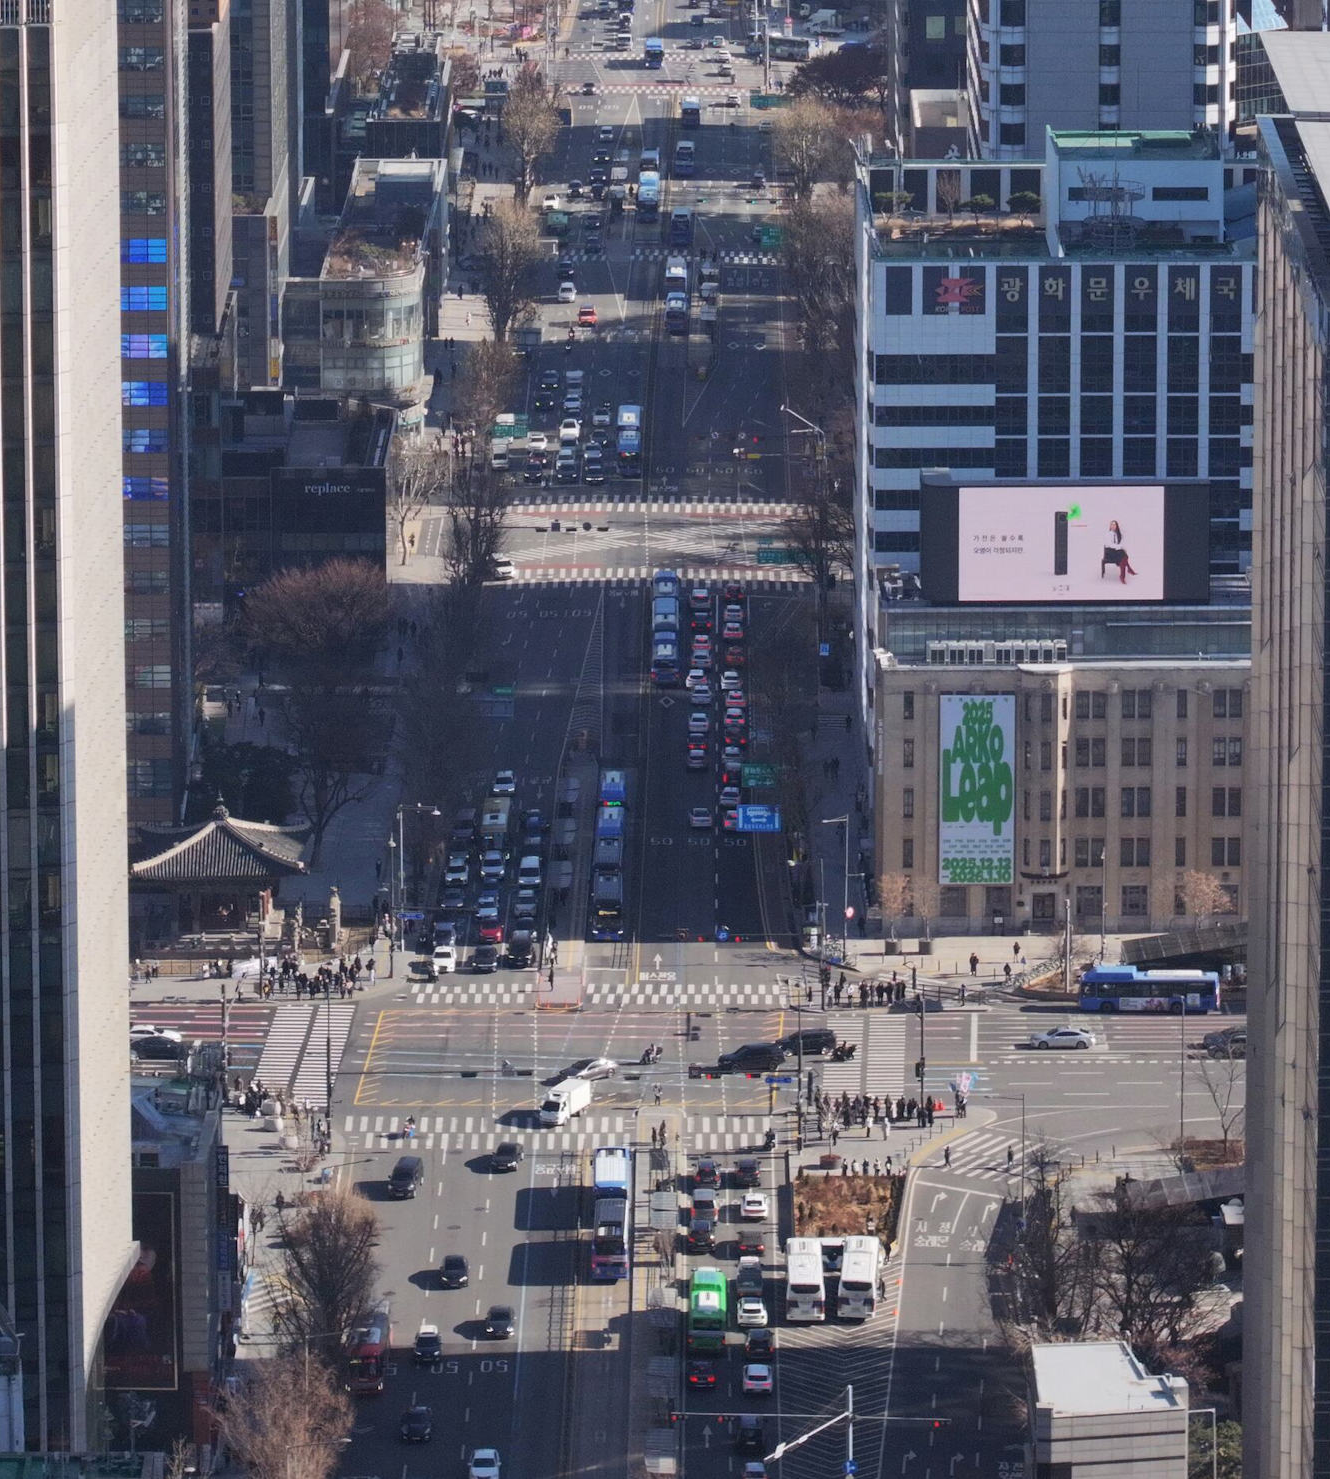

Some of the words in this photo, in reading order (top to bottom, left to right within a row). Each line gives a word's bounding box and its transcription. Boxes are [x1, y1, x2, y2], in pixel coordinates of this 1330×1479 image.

[1000, 277, 1238, 301] 광화문우체국
[304, 482, 351, 496] replace
[962, 701, 993, 726] 2025
[951, 725, 1004, 764] ARKO
[942, 748, 1013, 836] Leap
